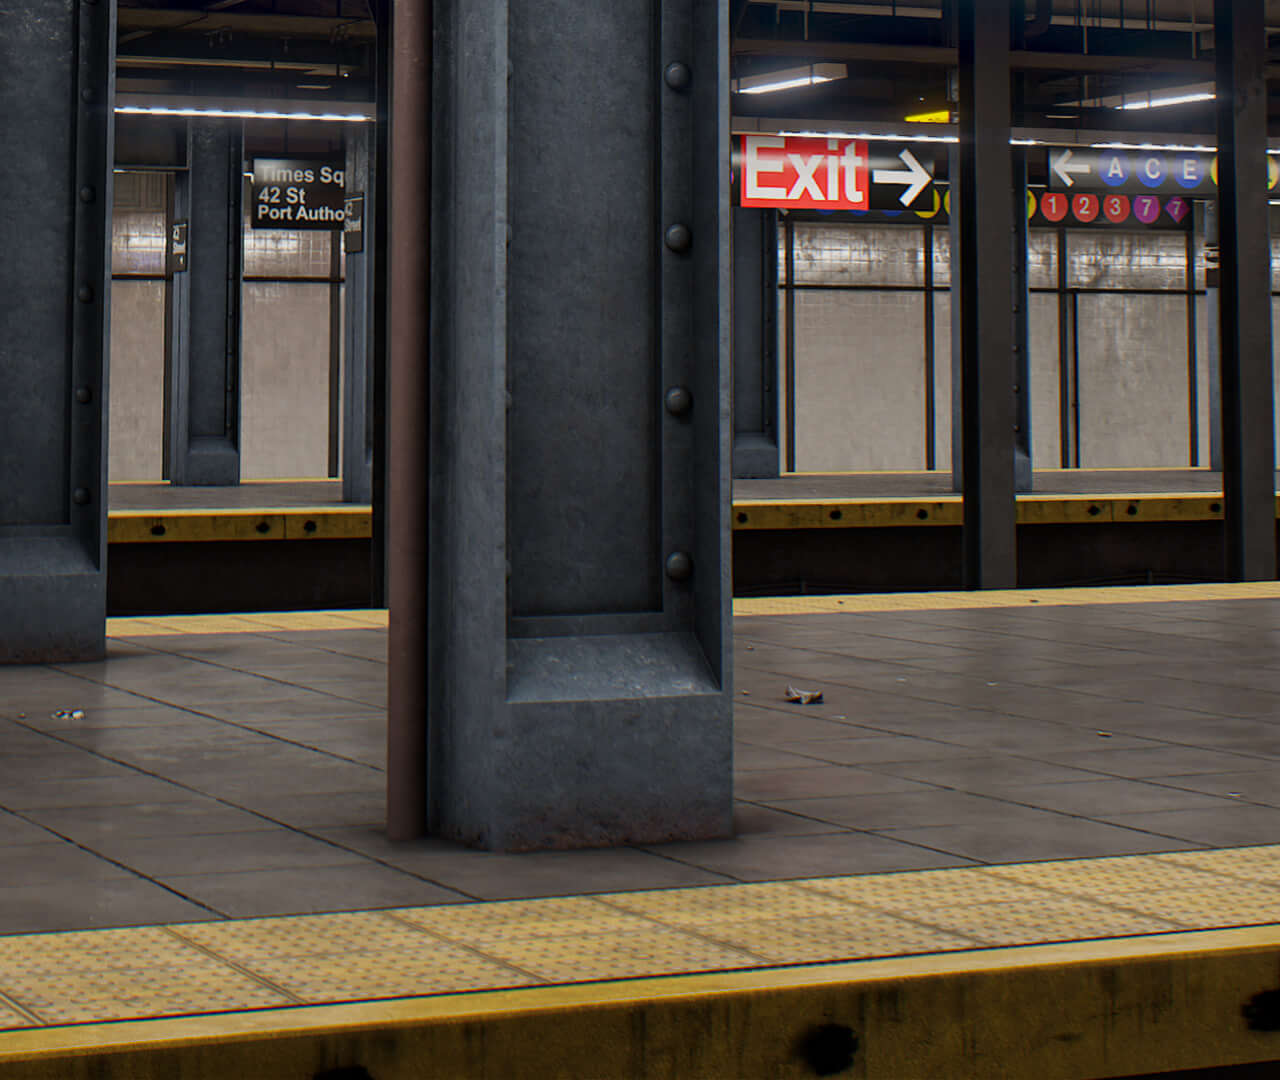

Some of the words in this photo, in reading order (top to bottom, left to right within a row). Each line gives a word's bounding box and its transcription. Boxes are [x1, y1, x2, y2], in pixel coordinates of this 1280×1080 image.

[745, 135, 864, 203] Exit
[258, 186, 281, 203] 42
[285, 186, 306, 204] St
[258, 204, 293, 220] Port
